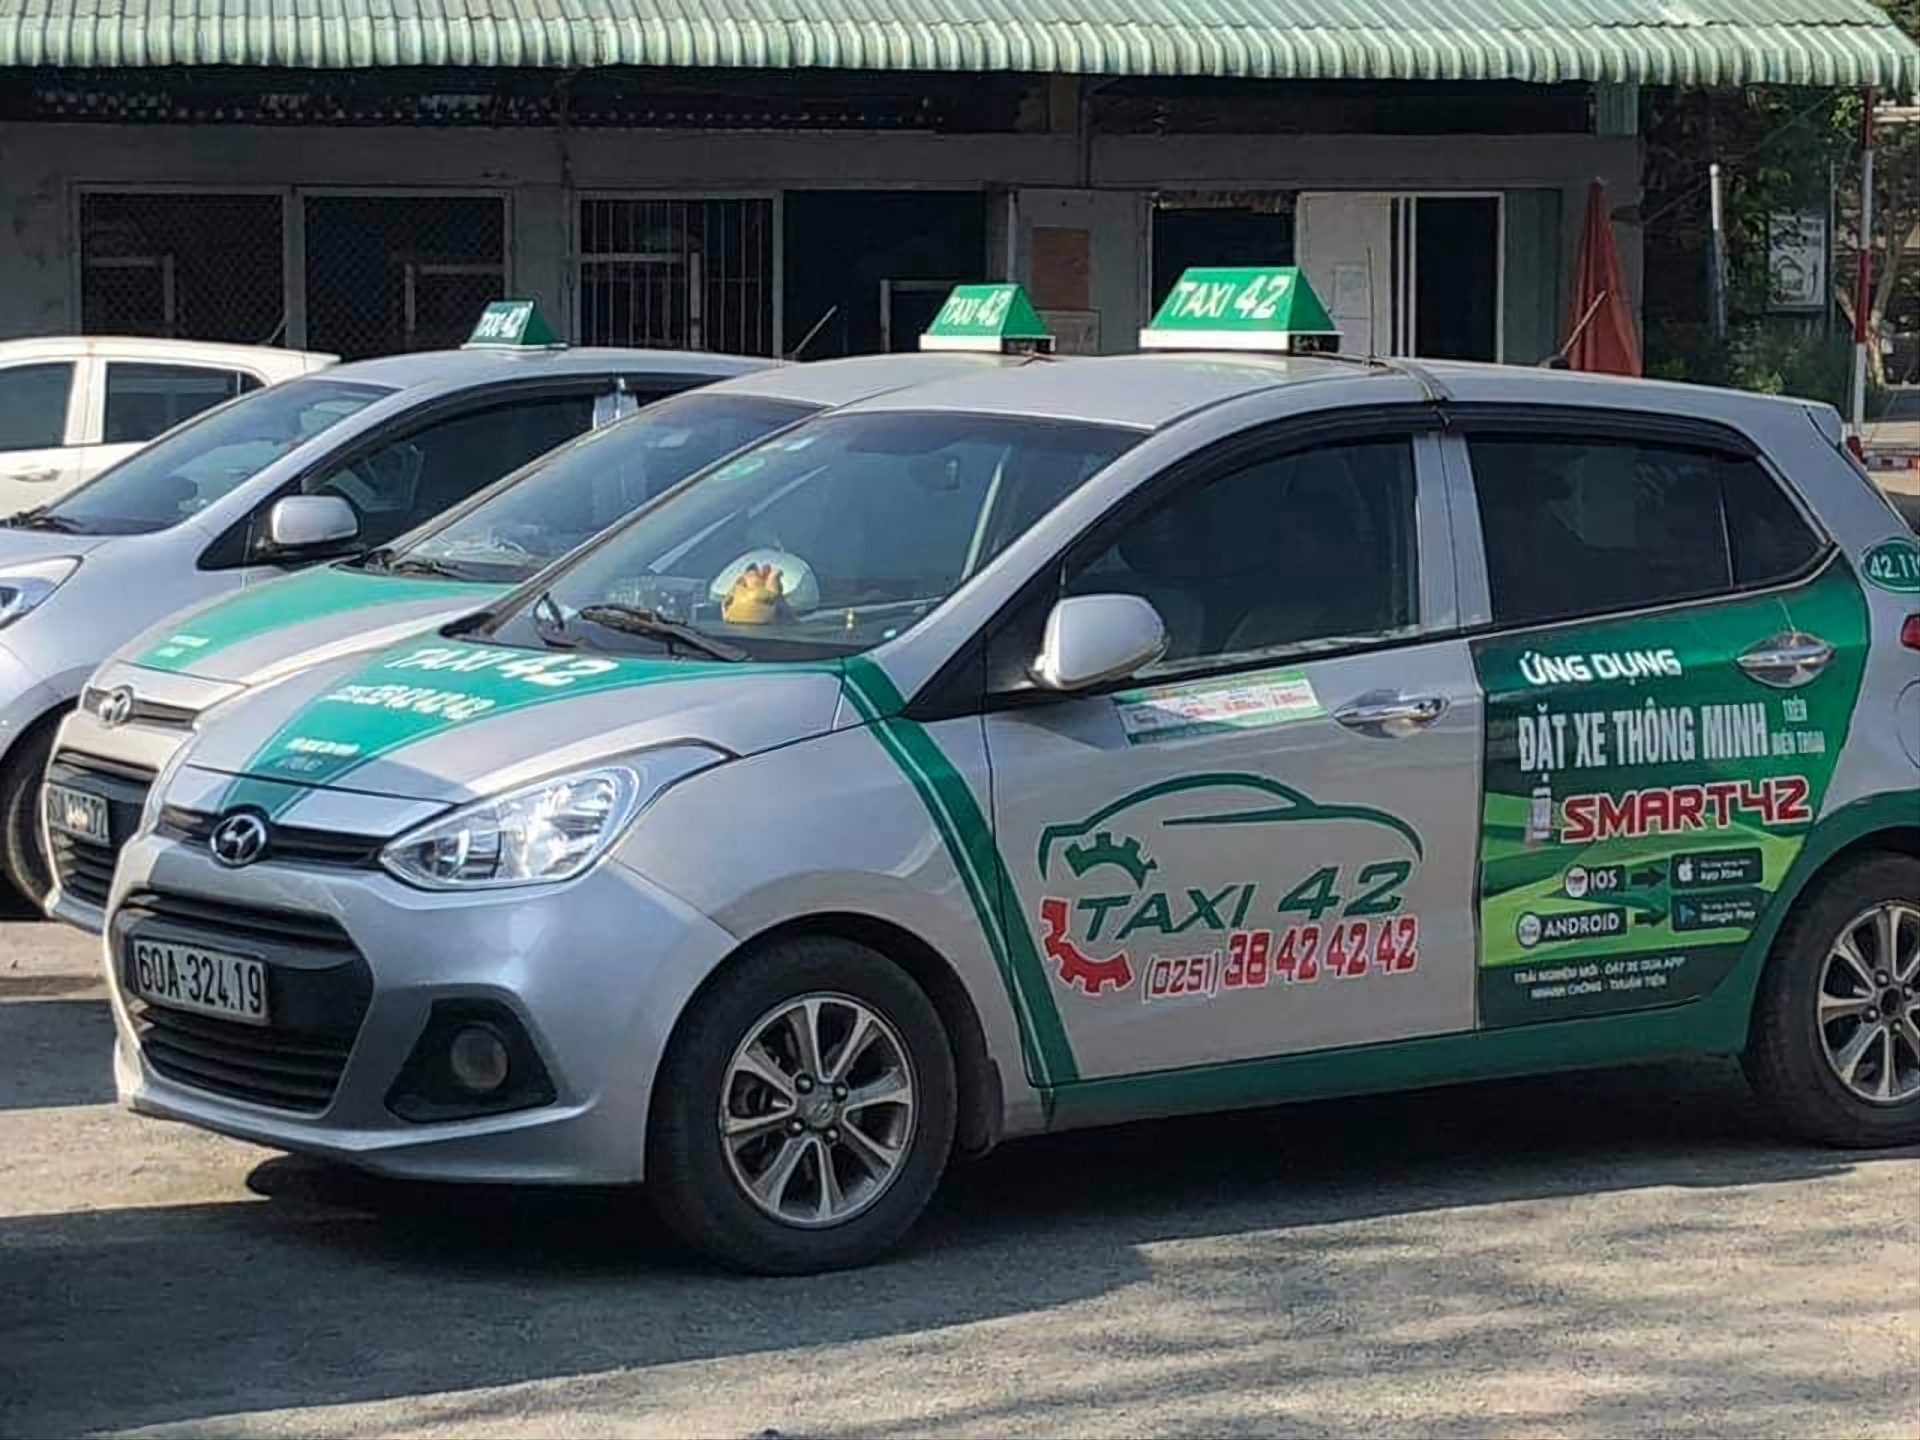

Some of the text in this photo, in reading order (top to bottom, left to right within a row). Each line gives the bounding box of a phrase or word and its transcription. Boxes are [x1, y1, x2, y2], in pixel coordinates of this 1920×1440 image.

[1170, 275, 1290, 319] TAXI 42
[384, 648, 619, 686] TAXI 42
[1518, 649, 1682, 686] ỨNG DỤNG
[1518, 703, 1567, 782] ĐẶT
[1572, 712, 1607, 768] XE
[1612, 696, 1695, 766] THÔNG
[1701, 702, 1768, 760] MINH
[1560, 775, 1813, 843] SMART42
[1076, 859, 1412, 942] TAXI 42
[1544, 912, 1619, 938] ANDROID
[1225, 928, 1270, 989] 38
[1276, 923, 1318, 982] 42
[1327, 919, 1368, 977] 42
[1376, 914, 1419, 974] 42
